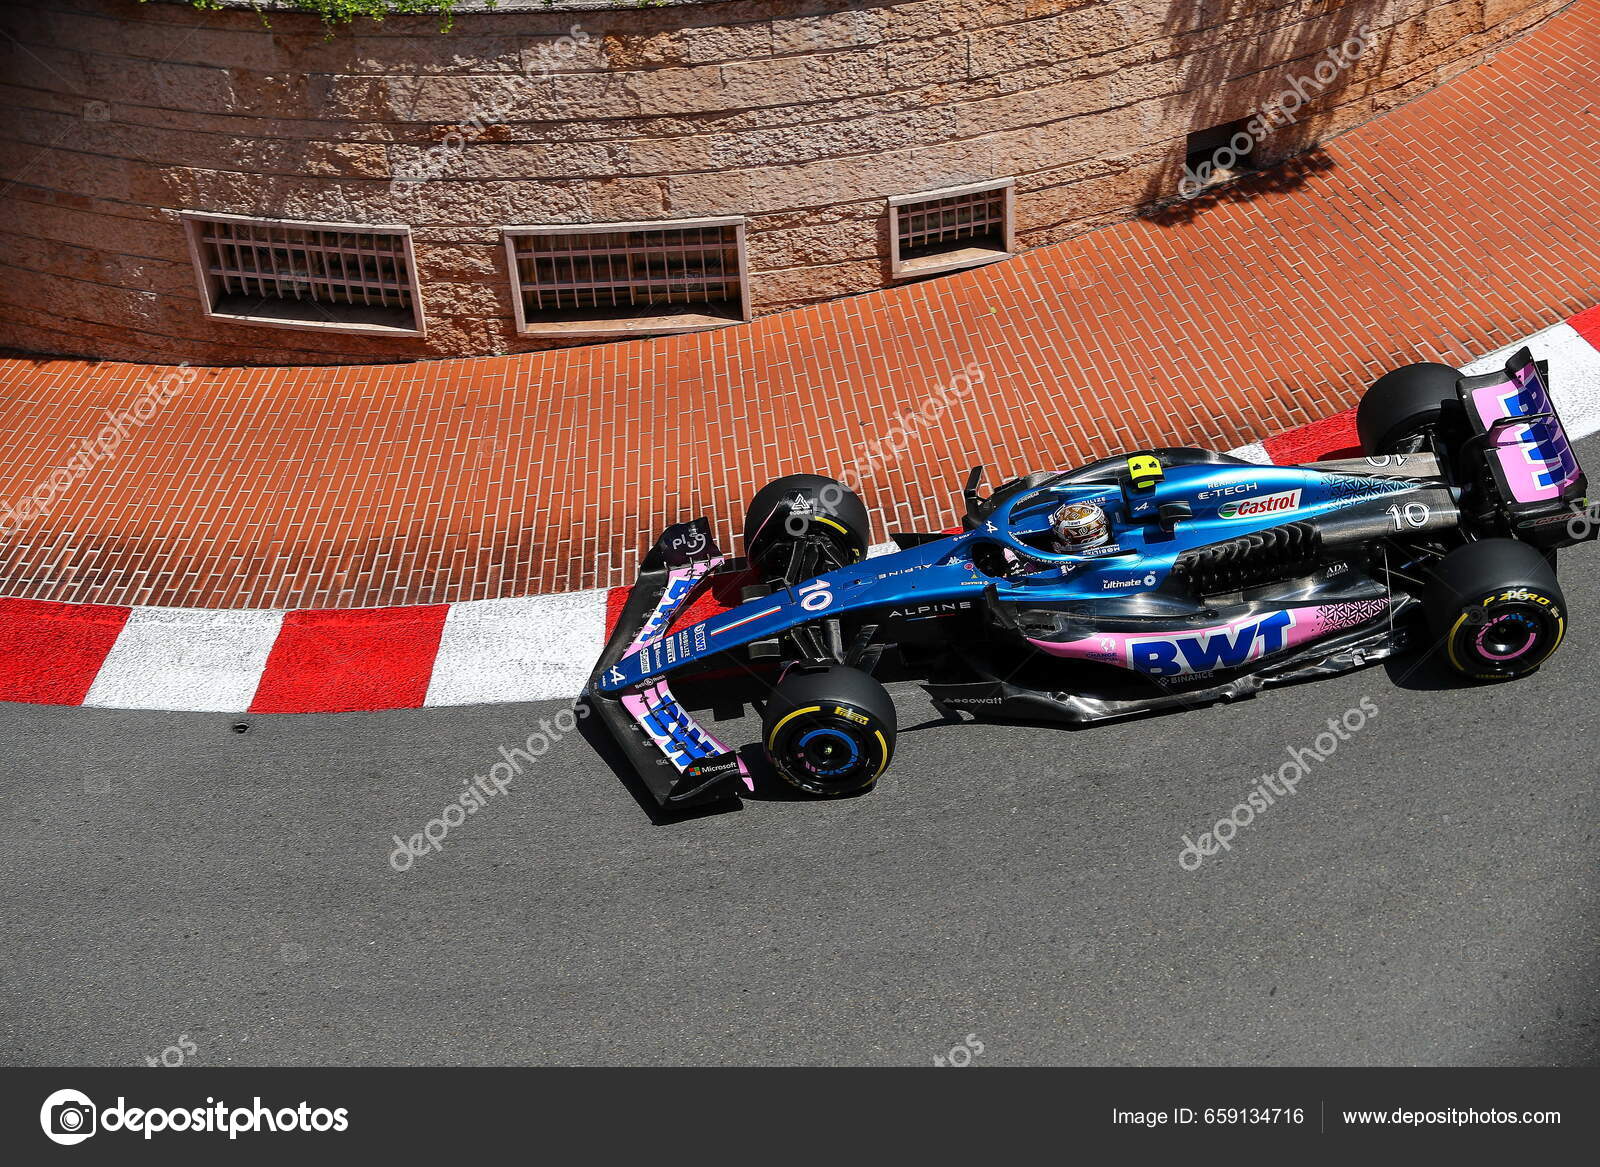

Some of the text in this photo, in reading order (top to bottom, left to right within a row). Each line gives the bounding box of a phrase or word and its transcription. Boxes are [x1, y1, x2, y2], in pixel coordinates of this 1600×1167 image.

[1198, 482, 1258, 500] E-TECH
[1237, 493, 1296, 516] Castrol
[1385, 502, 1431, 531] 10
[1103, 578, 1142, 589] ultimate
[798, 579, 834, 611] 10
[889, 601, 971, 618] ALPINE
[1131, 609, 1291, 677] BWT
[1172, 672, 1214, 684] BINANCE
[702, 762, 737, 774] Microsoft
